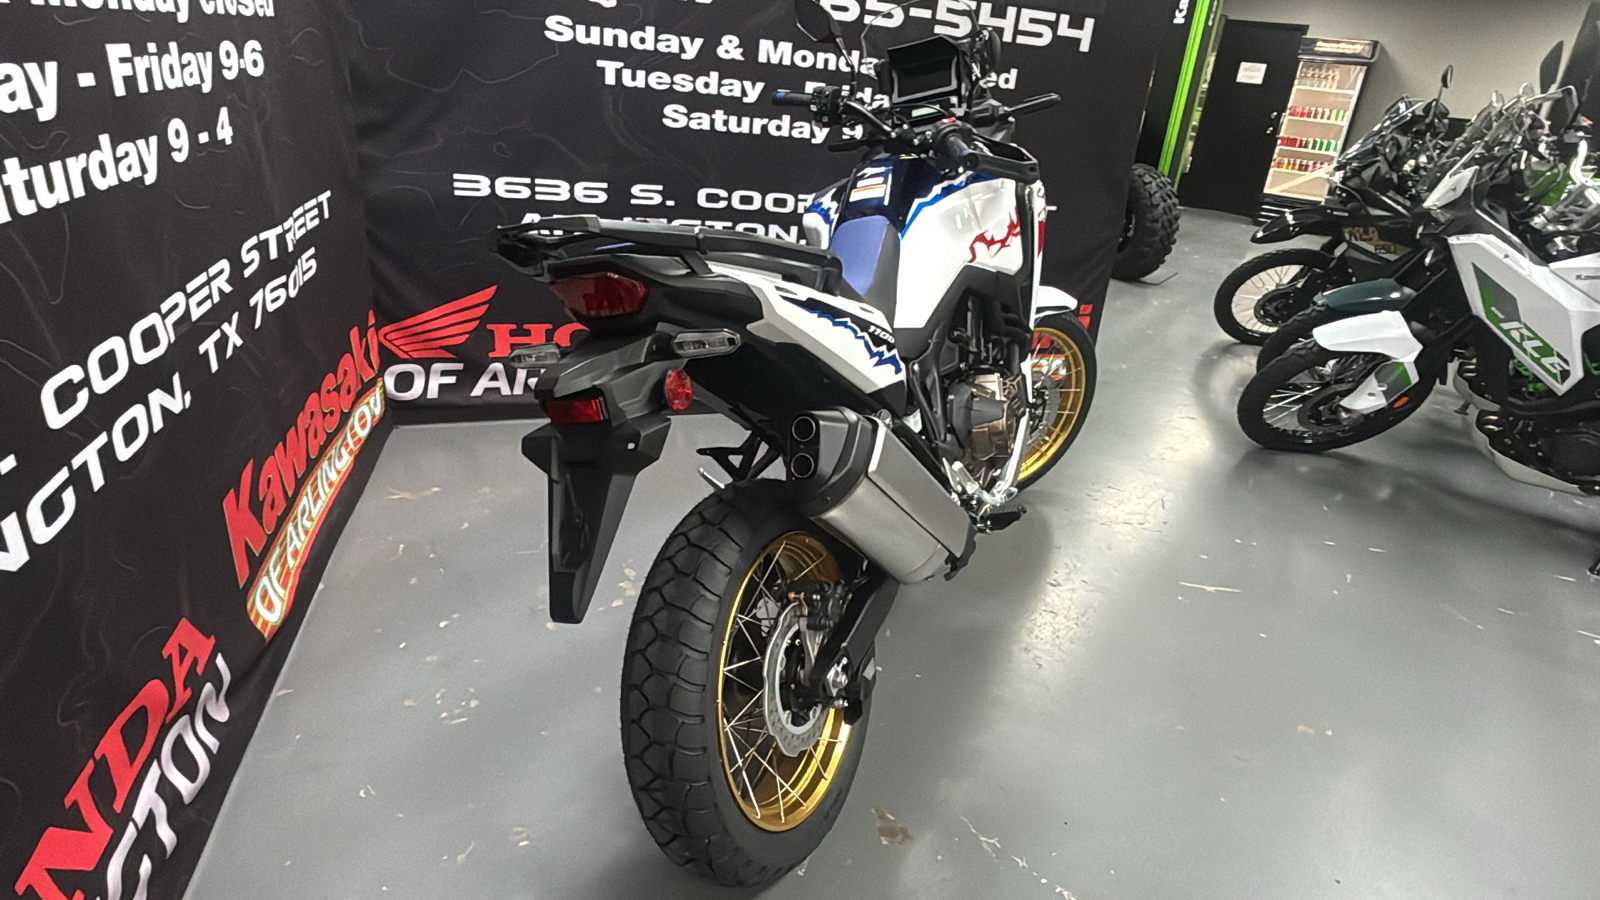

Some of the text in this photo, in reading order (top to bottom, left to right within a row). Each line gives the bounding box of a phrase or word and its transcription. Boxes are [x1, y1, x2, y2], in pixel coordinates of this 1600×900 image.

[105, 42, 213, 97] Friday
[544, 15, 879, 75] Sunday & Monda
[596, 59, 765, 103] Tuesday
[661, 103, 831, 144] Saturday
[0, 134, 158, 224] turday
[167, 117, 190, 162] 9
[216, 106, 234, 145] 4
[453, 173, 608, 204] 3636
[630, 184, 675, 206] S.
[40, 190, 331, 430] COOPER STREET
[198, 311, 244, 373] TX
[249, 247, 317, 329] 76015
[868, 325, 895, 344] 1100
[383, 362, 464, 401] OF
[222, 309, 381, 589] Kawasaki
[254, 547, 286, 624] OF
